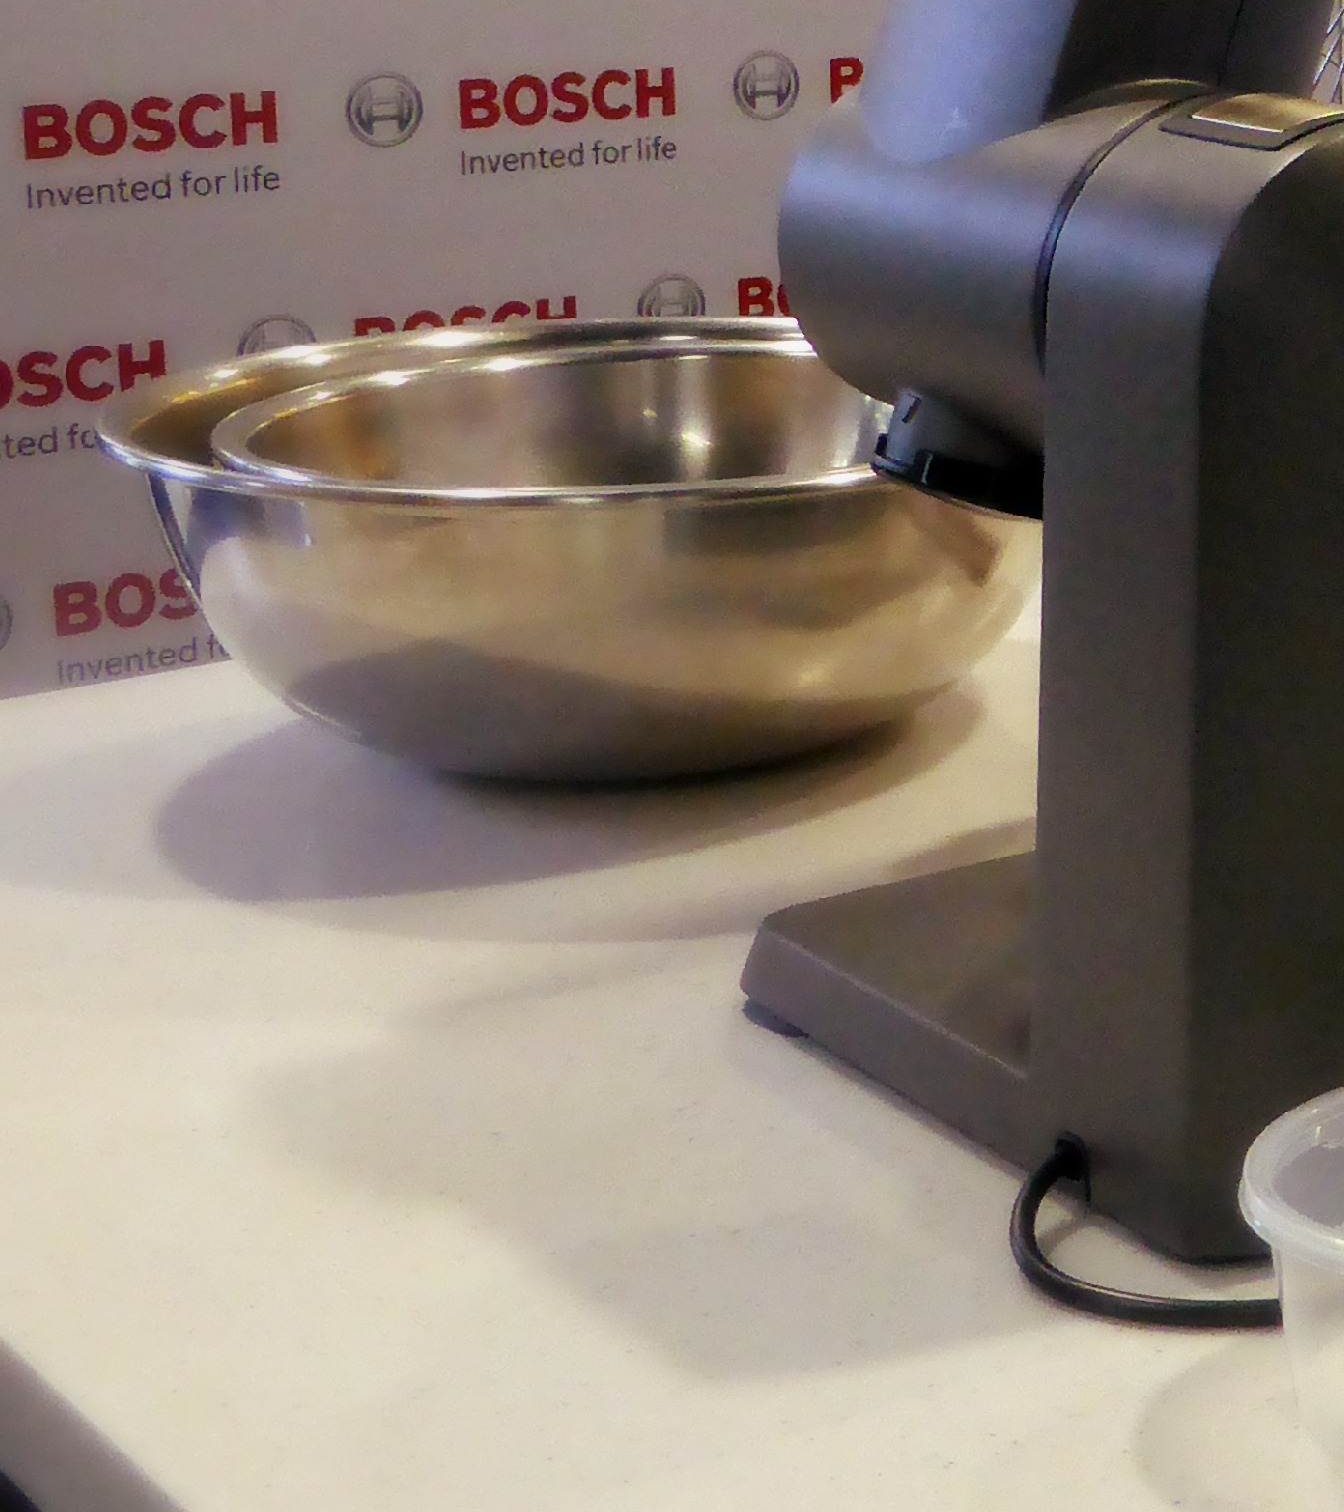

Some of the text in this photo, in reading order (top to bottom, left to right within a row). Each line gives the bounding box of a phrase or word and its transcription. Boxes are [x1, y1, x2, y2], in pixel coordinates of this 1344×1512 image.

[23, 90, 279, 161] BOSCH
[459, 67, 677, 130] BOSCH
[27, 165, 280, 208] Invented for life
[461, 135, 677, 175] Invented for life
[0, 339, 168, 409] SCH
[54, 568, 198, 637] BOS
[58, 637, 198, 684] Invented
